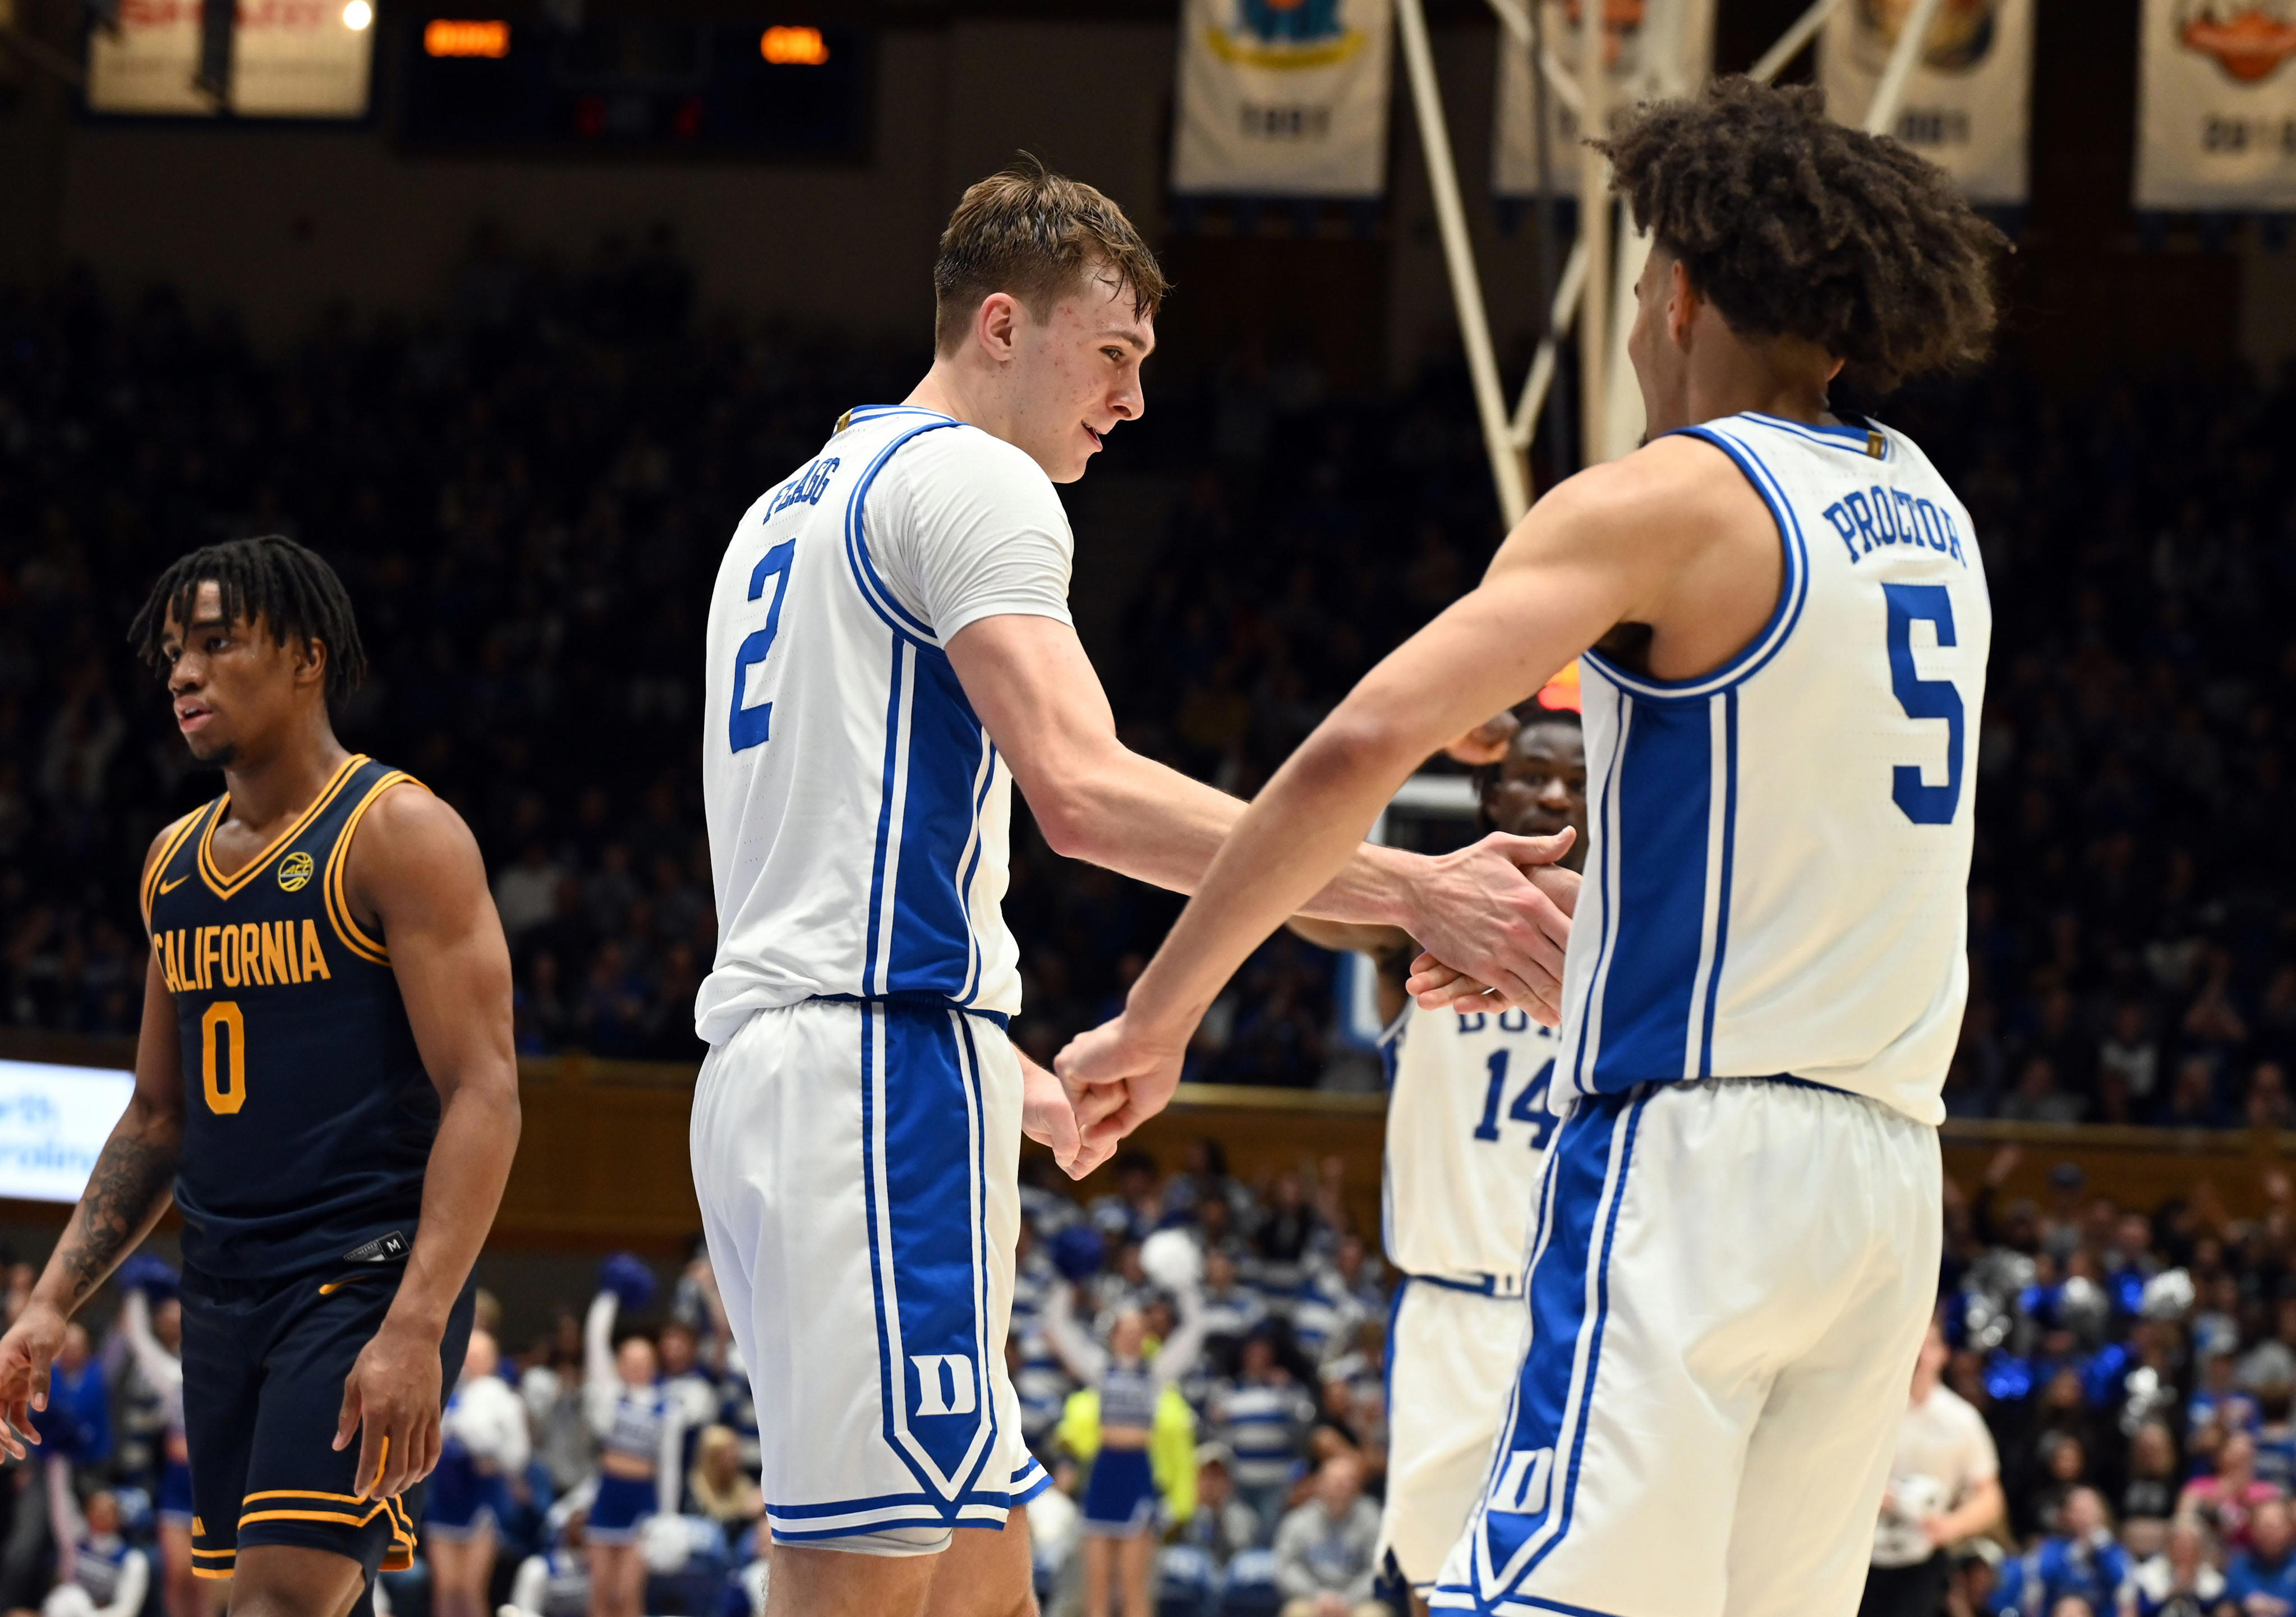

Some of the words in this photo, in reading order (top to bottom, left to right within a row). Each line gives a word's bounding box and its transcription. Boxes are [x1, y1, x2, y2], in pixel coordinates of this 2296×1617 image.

[763, 457, 840, 525] FLAGG
[1822, 485, 1967, 568] PROCTOR
[729, 538, 797, 754] 2
[1881, 581, 1964, 825] 5
[154, 919, 332, 993] CALIFORNIA
[202, 1001, 246, 1114] 0
[1474, 1049, 1561, 1151] 14
[386, 1238, 402, 1252] M
[909, 1354, 976, 1416] D
[1487, 1446, 1555, 1514] D
